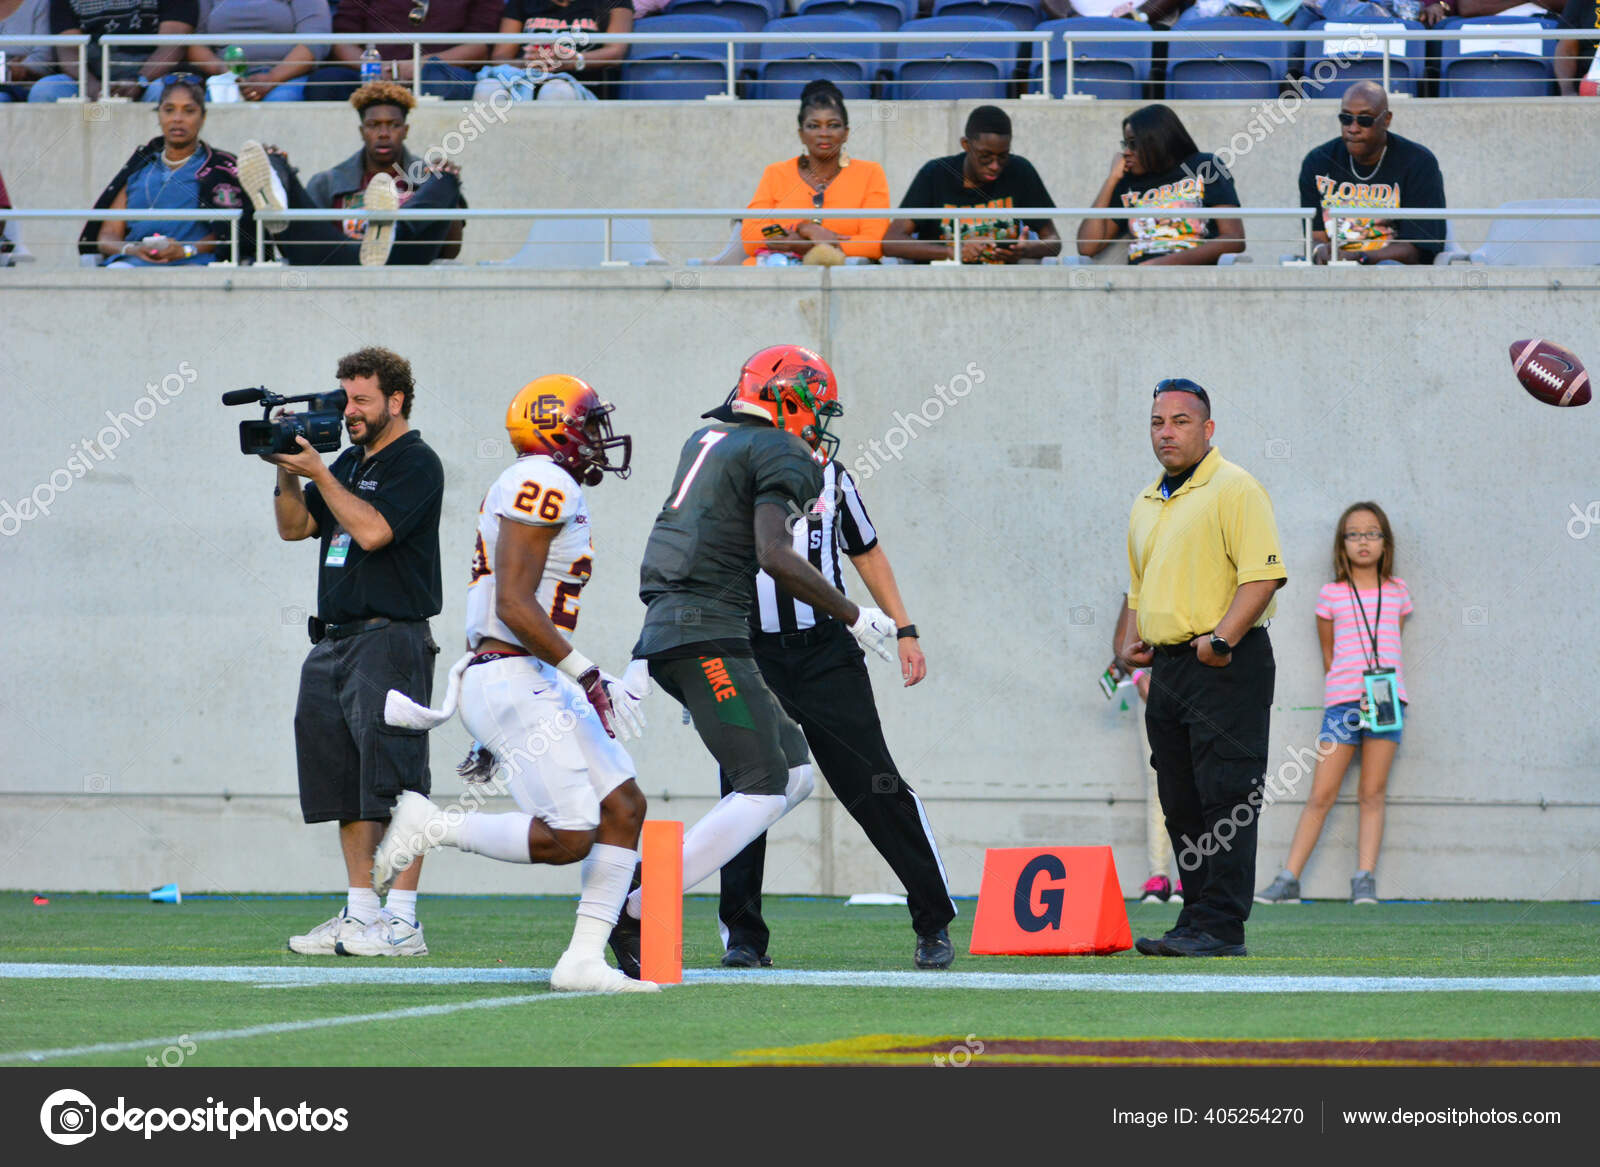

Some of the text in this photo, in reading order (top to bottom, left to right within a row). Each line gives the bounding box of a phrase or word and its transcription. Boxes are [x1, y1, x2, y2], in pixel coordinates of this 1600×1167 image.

[1121, 174, 1205, 208] FLORIDA
[1315, 174, 1400, 208] FLORIDA
[513, 480, 566, 522] 26
[810, 529, 822, 549] S
[700, 656, 737, 703] RIKE
[1013, 854, 1066, 933] G
